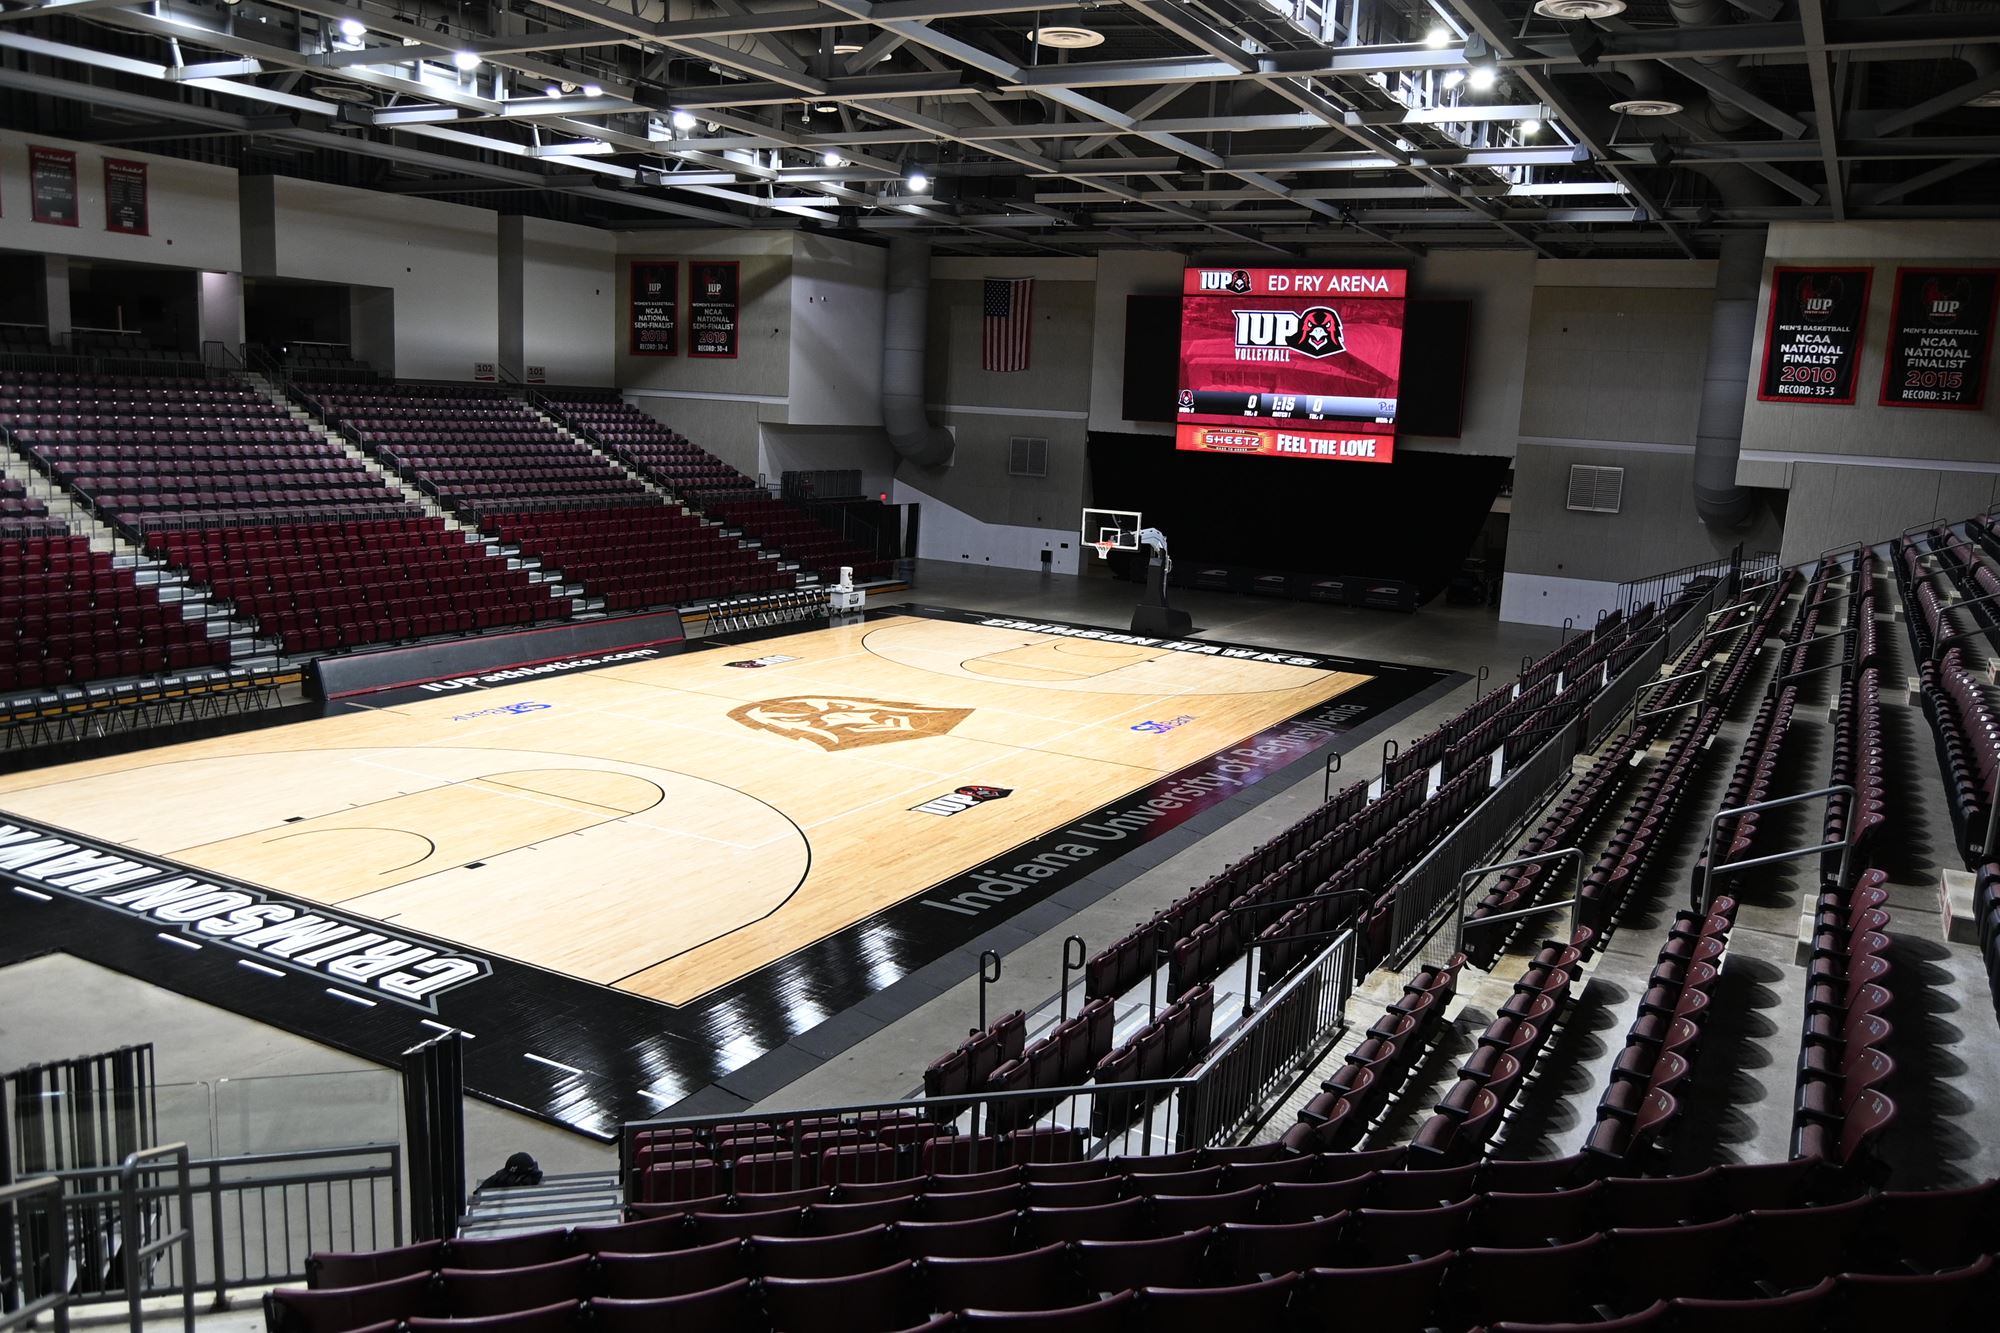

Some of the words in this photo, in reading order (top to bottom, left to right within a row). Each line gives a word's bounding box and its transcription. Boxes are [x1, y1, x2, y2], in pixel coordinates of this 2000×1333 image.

[1201, 271, 1232, 290] IUP
[1268, 275, 1290, 292] ED
[1294, 275, 1324, 292] FRY
[1326, 275, 1389, 293] ARENA
[648, 283, 662, 291] IUP
[708, 283, 722, 292] IUP
[1807, 298, 1832, 311] IUP
[1932, 300, 1960, 313] IUP
[645, 307, 663, 315] NCAA
[704, 308, 723, 316] NCAA
[638, 314, 670, 322] NATIONAL
[697, 315, 730, 323] NATIONAL
[692, 323, 734, 331] SEMI-FINALIST
[1237, 312, 1299, 346] IUP
[1802, 325, 1851, 333] BASKETBALL
[1928, 328, 1979, 336] BASKETBALL
[1795, 334, 1831, 344] NCAA
[1920, 337, 1958, 347] NCAA
[1235, 347, 1290, 362] VOLLEYBALL
[1780, 344, 1843, 355] NATIONAL
[1904, 347, 1971, 358] NATIONAL
[1783, 354, 1839, 365] FINALIST
[1907, 358, 1966, 369] FINALIST
[477, 364, 493, 372] 102
[529, 368, 543, 376] 101
[1780, 365, 1837, 384] 2010
[1904, 370, 1963, 388] 2015
[1778, 385, 1814, 395] RECORD:
[1815, 386, 1835, 396] 33-3
[1902, 389, 1940, 400] RECORD:
[1941, 391, 1961, 401] 31-7
[1247, 395, 1258, 409] 0
[1272, 396, 1296, 411] 1:15
[1312, 399, 1323, 413] 0
[1378, 401, 1394, 412] Pitt
[1205, 434, 1261, 446] SHEETZ
[1277, 433, 1308, 454] FEEL
[1309, 438, 1337, 455] THE
[1340, 439, 1376, 457] LOVE
[980, 618, 1156, 647] CRIMSON
[1160, 640, 1319, 667] HAWKS
[419, 647, 660, 693] IUPathletics.com
[1240, 703, 1369, 763] Pennsylvania
[1216, 748, 1265, 787] of
[910, 793, 981, 817] IUP
[1066, 770, 1230, 842] University
[918, 842, 1100, 917] Indiana
[101, 877, 479, 1000] CRIMSON
